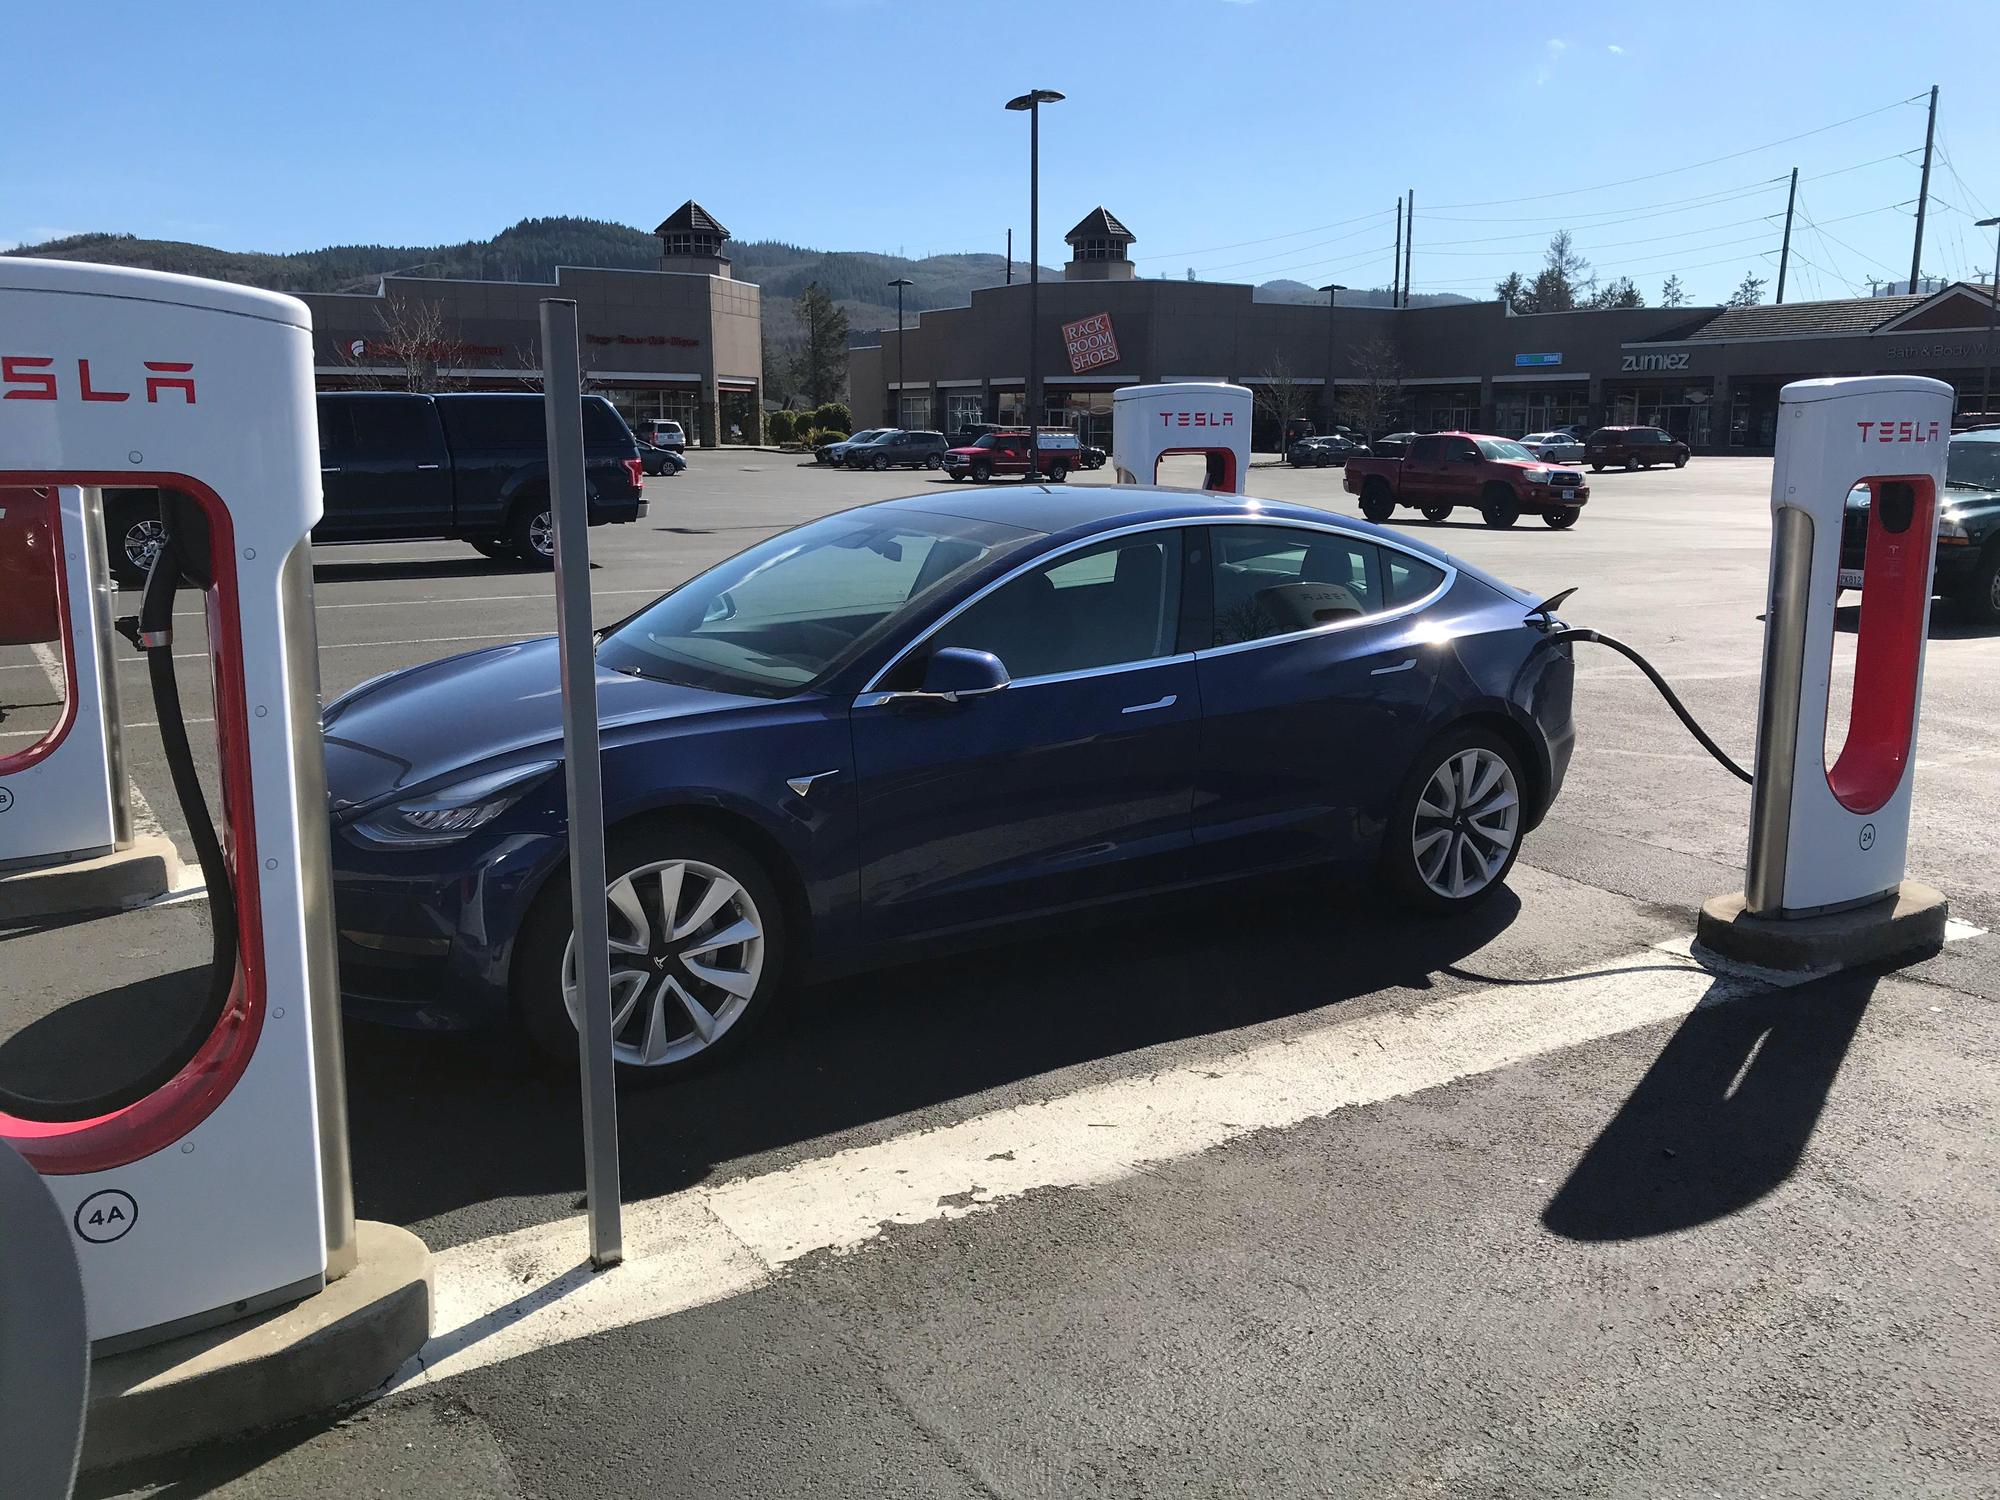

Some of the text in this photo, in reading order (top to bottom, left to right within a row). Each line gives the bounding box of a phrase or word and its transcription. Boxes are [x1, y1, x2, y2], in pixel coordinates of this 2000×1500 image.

[1068, 318, 1104, 339] RACK
[1069, 332, 1111, 354] ROOM
[1887, 346, 1918, 359] Bath
[1072, 346, 1115, 369] SHOES
[1621, 353, 1690, 371] zumiez
[1159, 412, 1233, 426] TESLA
[1857, 421, 1939, 442] TESLA
[88, 1206, 126, 1226] 4A
